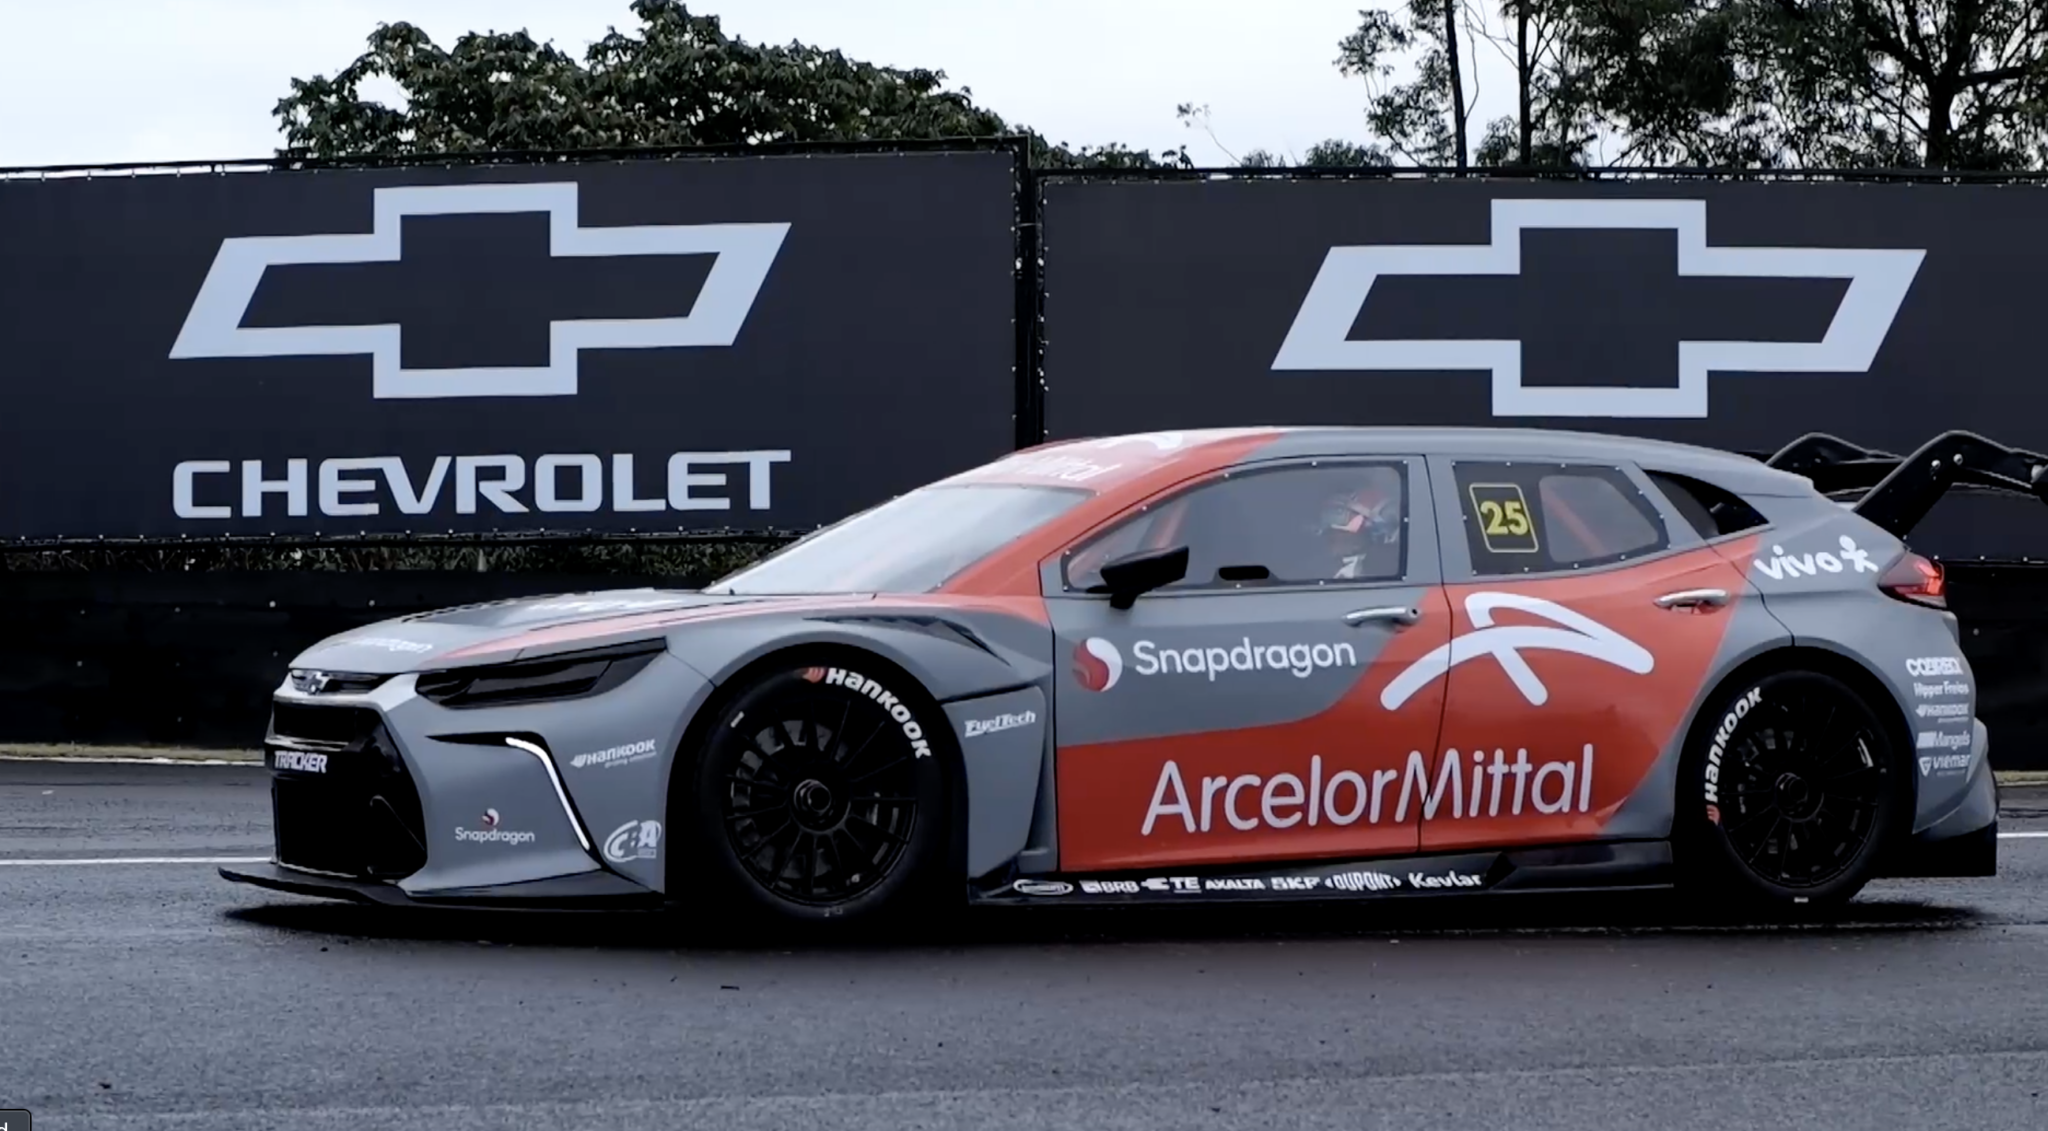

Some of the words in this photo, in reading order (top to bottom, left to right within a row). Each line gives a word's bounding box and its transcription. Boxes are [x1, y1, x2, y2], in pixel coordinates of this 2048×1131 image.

[173, 450, 791, 518] CHEVROLET
[1480, 501, 1528, 535] 25
[1753, 544, 1843, 580] vivo
[1132, 637, 1357, 682] Snapdragon
[964, 710, 1036, 738] FuelTech
[274, 750, 328, 774] TRACKER
[1141, 743, 1593, 836] ArcelorMittal
[455, 826, 535, 844] Snapdragon
[1100, 881, 1140, 893] BRB
[1170, 877, 1199, 890] TE
[1205, 878, 1266, 890] AXALTA
[1271, 876, 1320, 890] SKF
[1333, 872, 1396, 891] DUPONT
[1408, 871, 1482, 888] Kevlar
